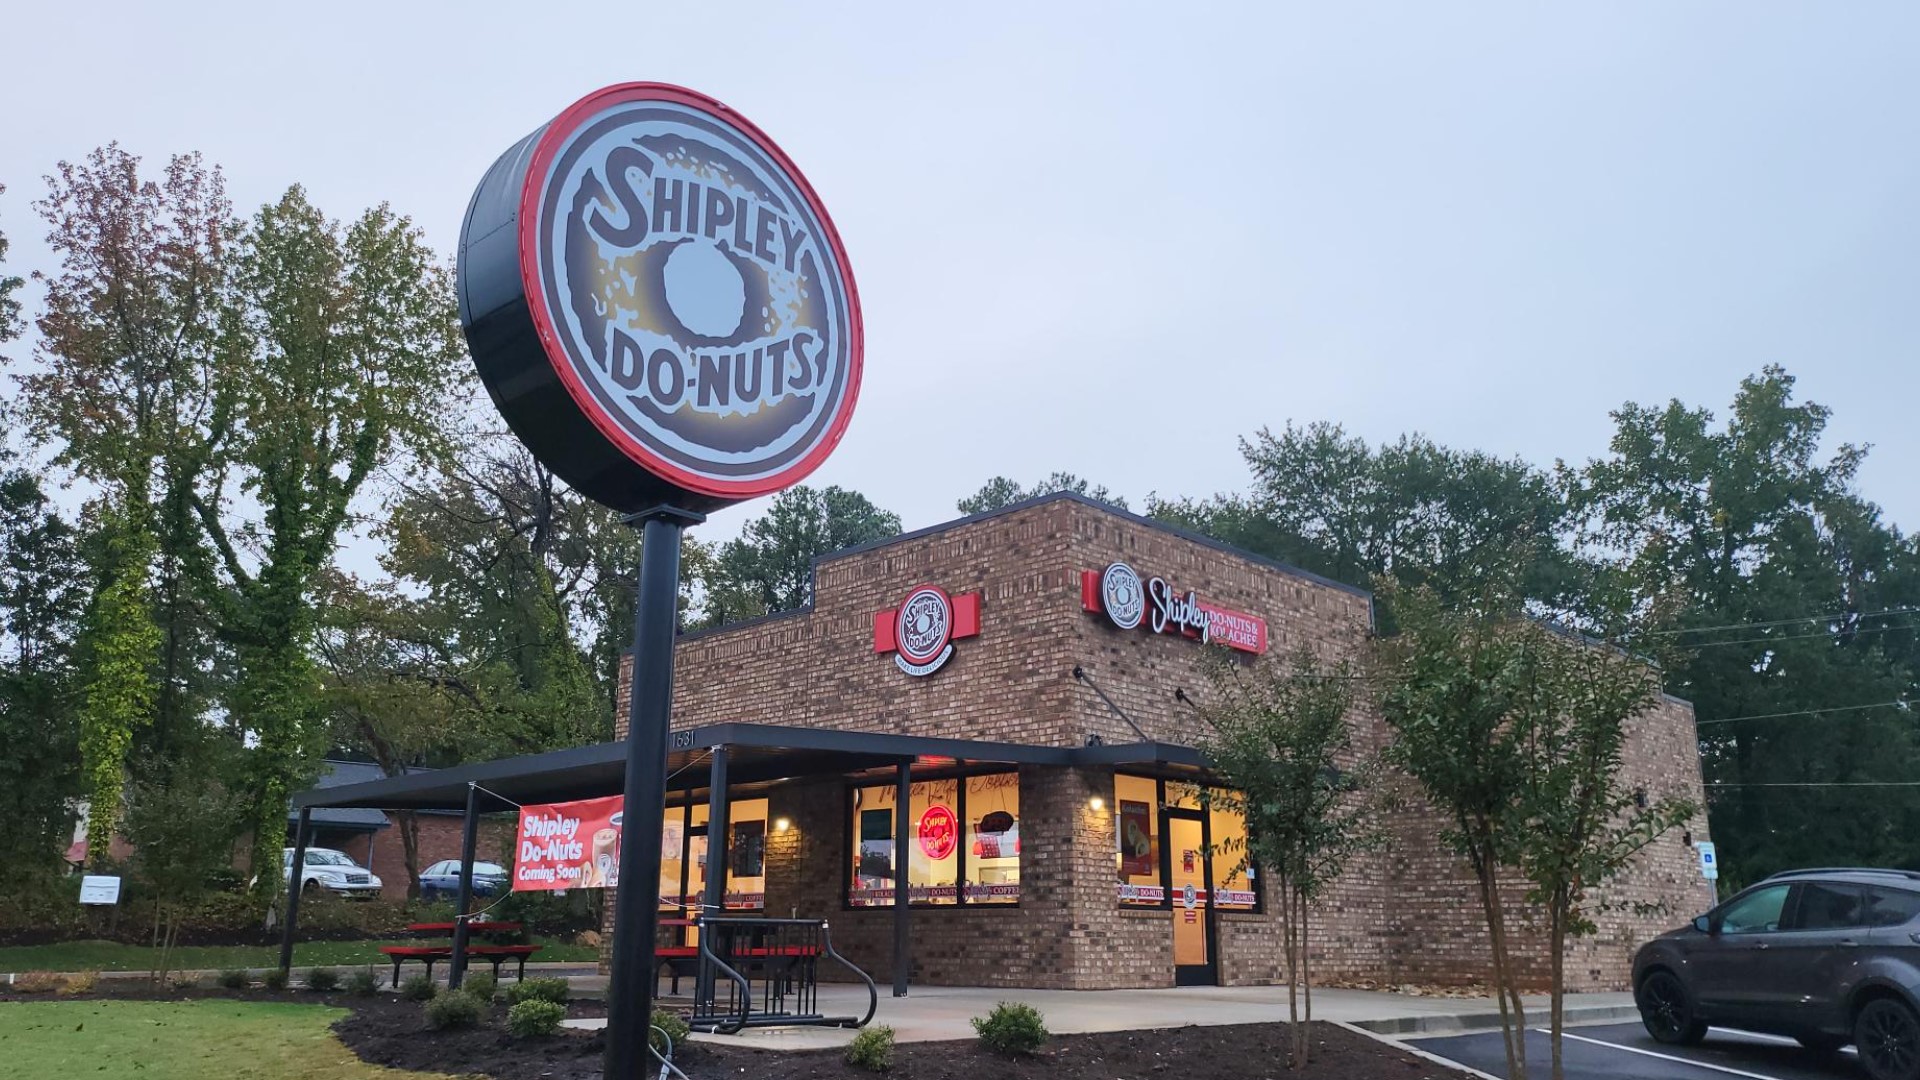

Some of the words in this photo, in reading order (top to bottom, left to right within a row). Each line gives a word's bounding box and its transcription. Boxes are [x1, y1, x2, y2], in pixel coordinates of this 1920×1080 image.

[588, 146, 806, 273] SHIPLEY
[611, 327, 814, 407] DO-NUTS
[1109, 573, 1136, 590] SHIPLEY
[906, 602, 940, 624] SHIPLEY
[1149, 577, 1211, 645] Shipley
[1209, 610, 1251, 633] DO-NUTS
[1251, 622, 1258, 636] &
[672, 730, 694, 748] 1631
[523, 813, 580, 842] Shipley
[520, 839, 583, 863] Do-Nuts
[519, 864, 555, 883] Coming
[556, 863, 581, 879] Soon
[1140, 888, 1164, 899] DO-NUTS
